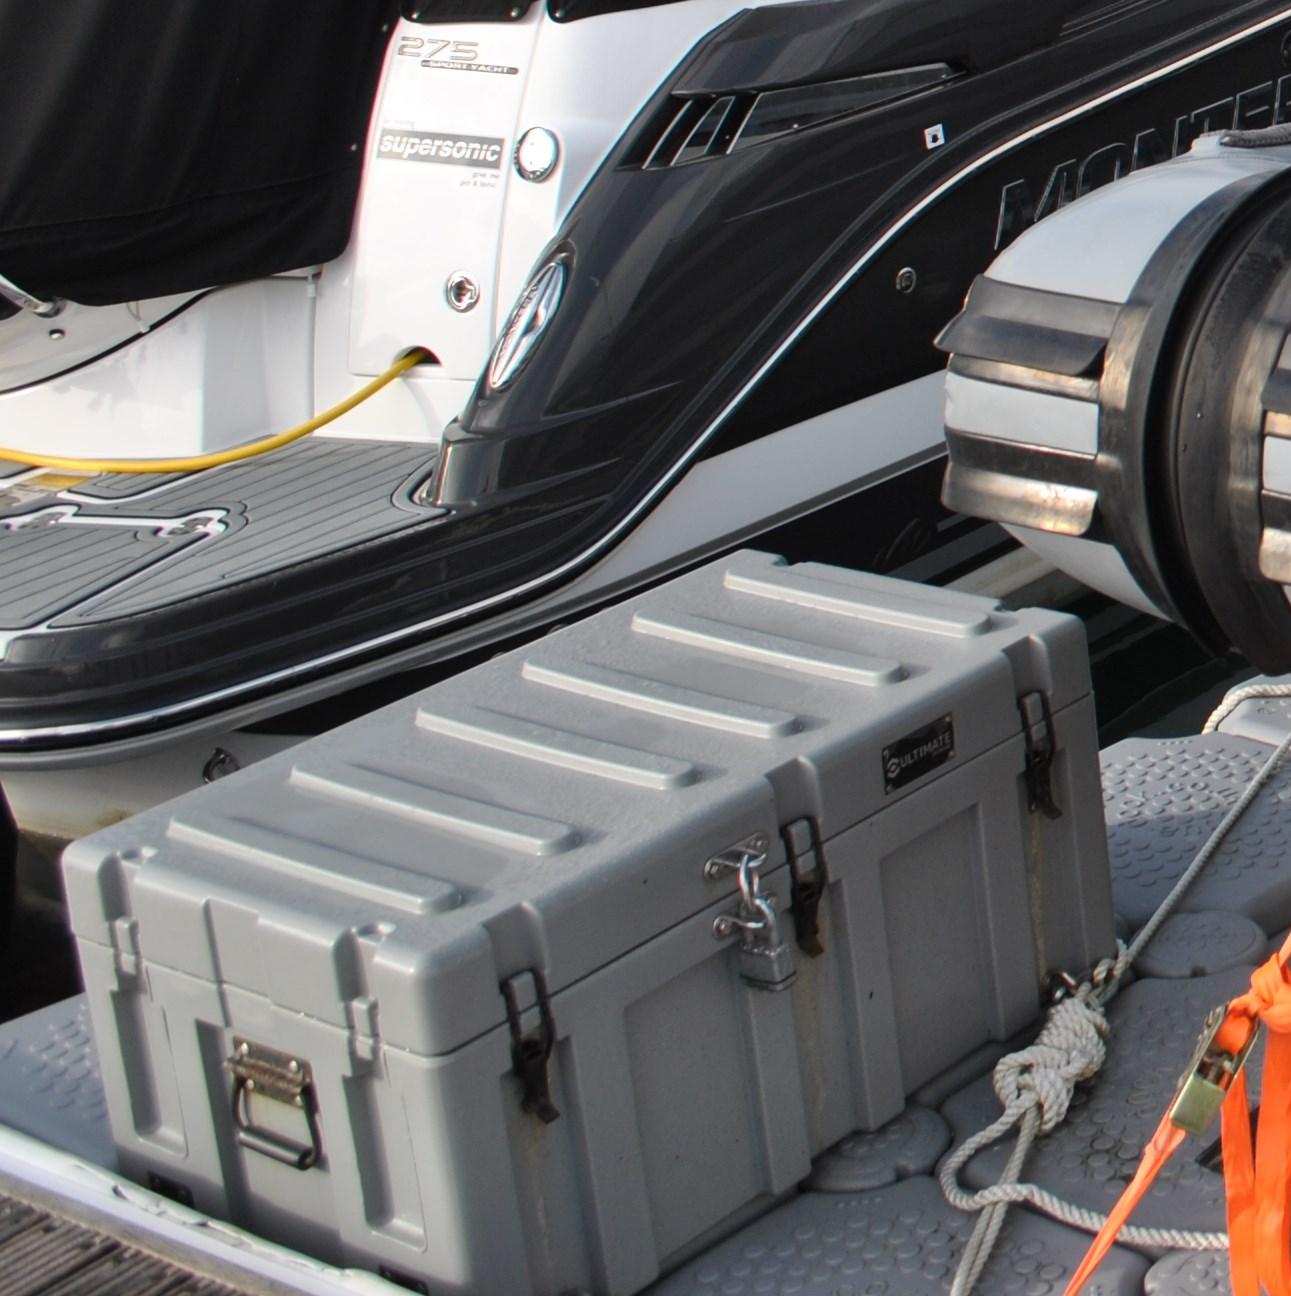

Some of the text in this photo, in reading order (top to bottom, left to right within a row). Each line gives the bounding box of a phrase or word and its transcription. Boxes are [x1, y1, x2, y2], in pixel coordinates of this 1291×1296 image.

[398, 35, 480, 61] 275
[380, 134, 501, 162] supersonic
[899, 731, 952, 768] ULTIMATE
